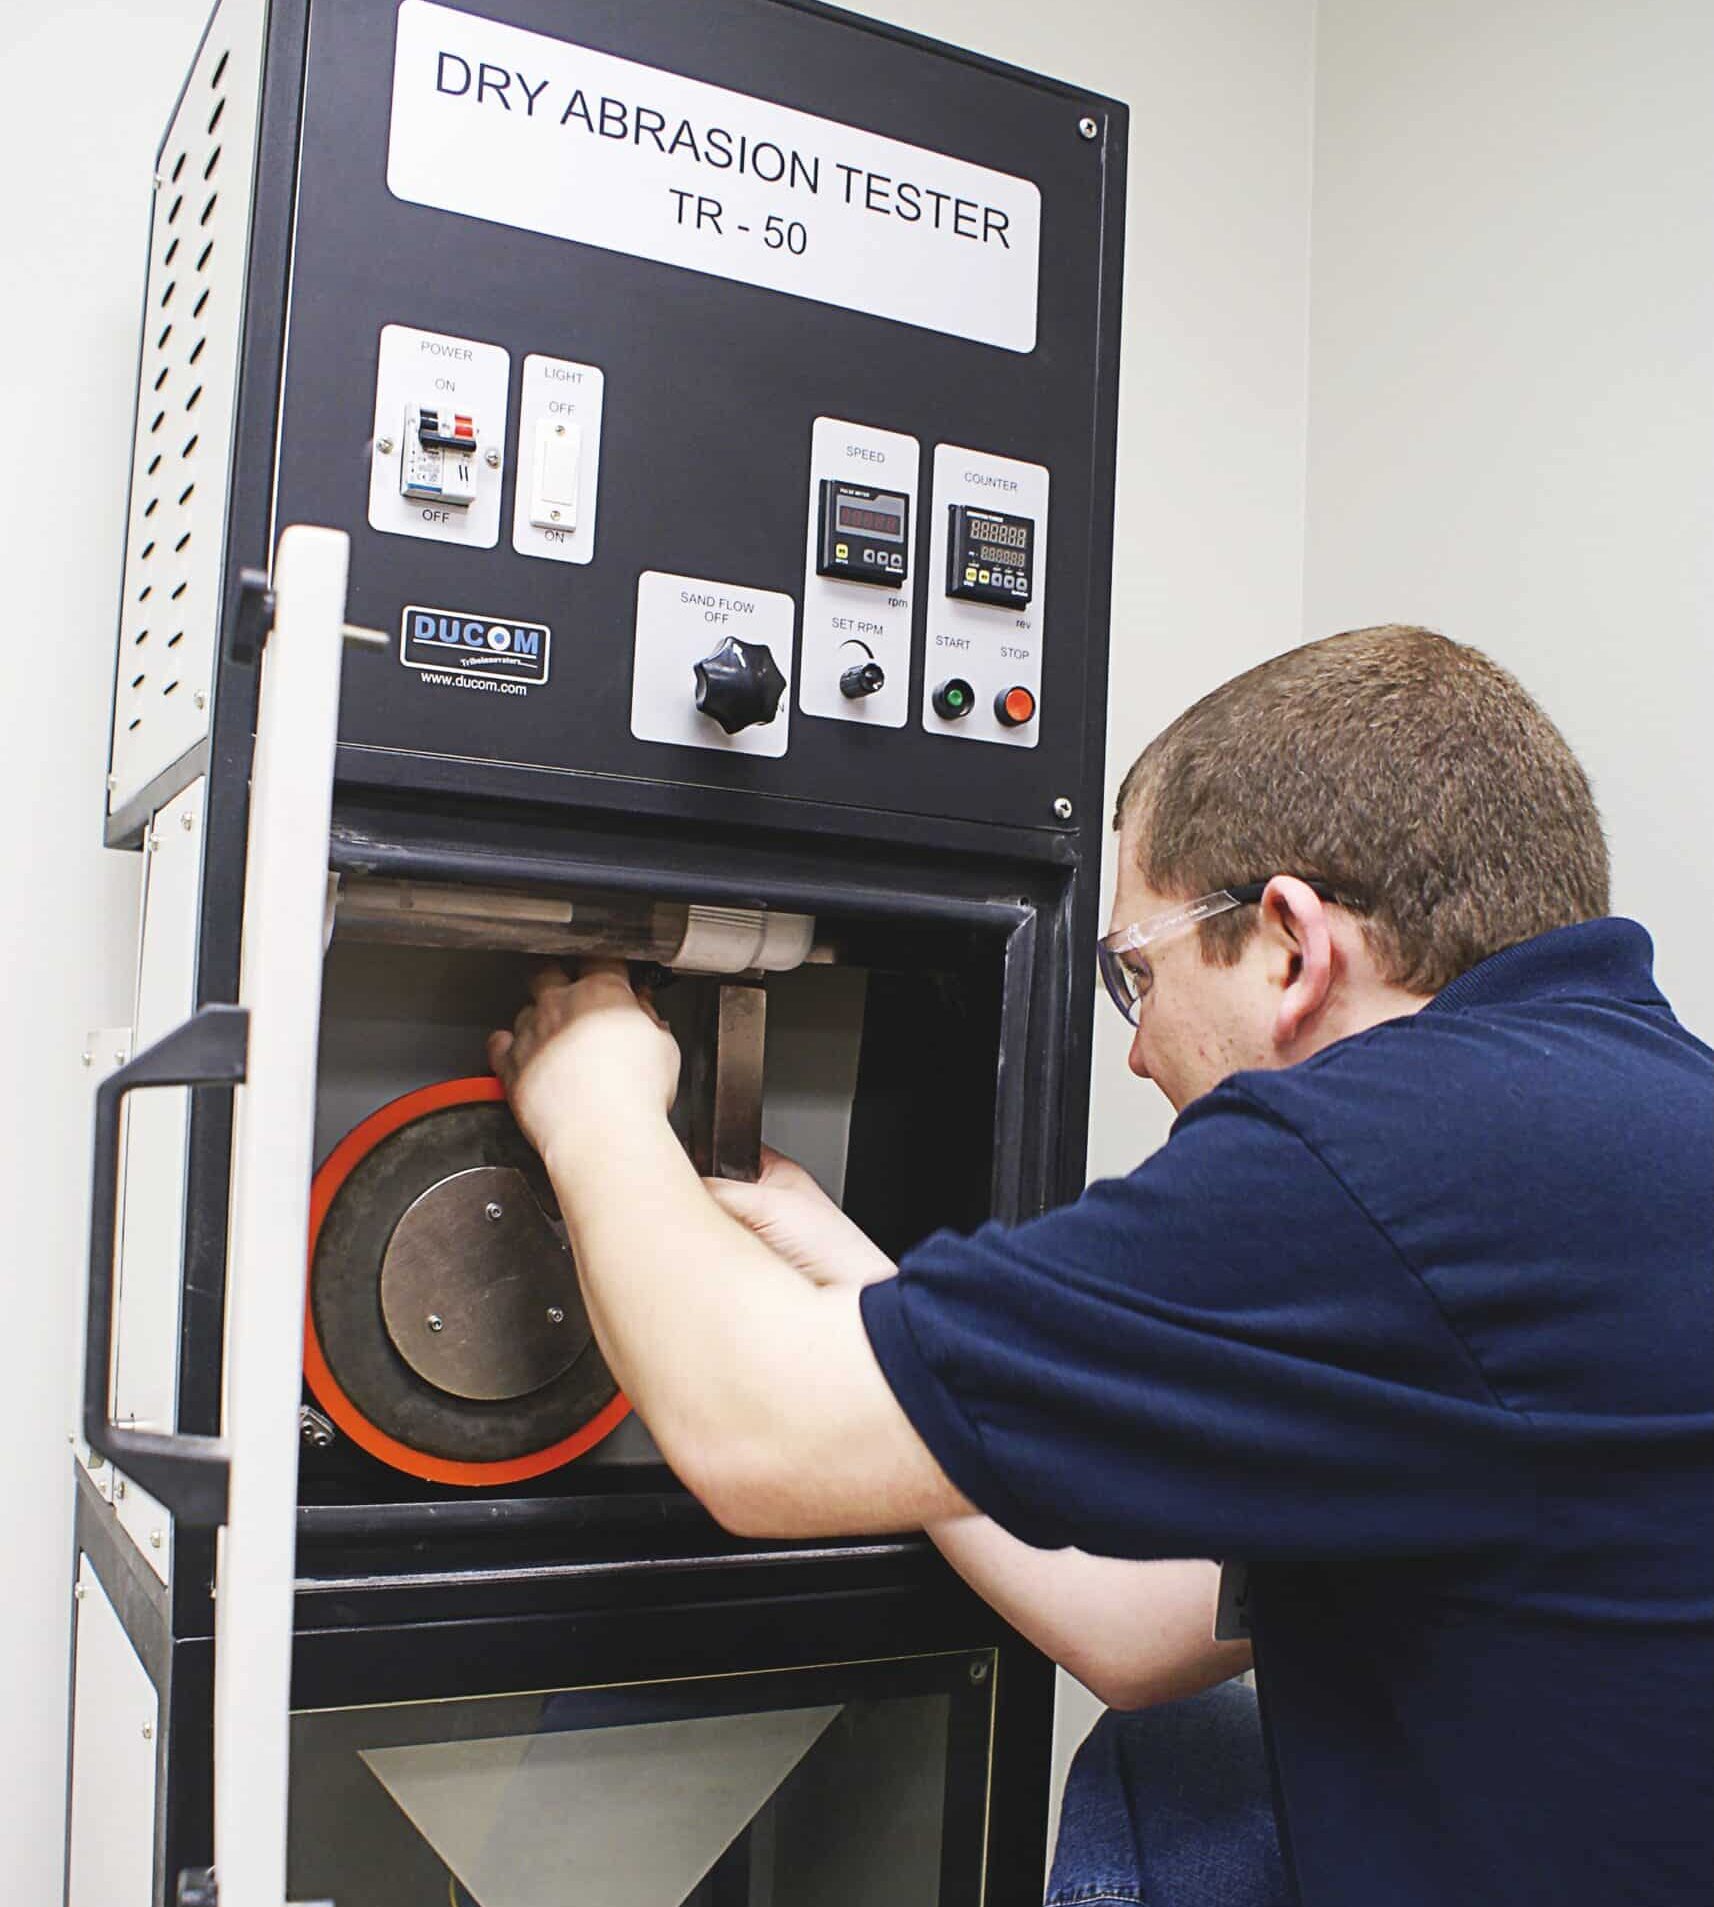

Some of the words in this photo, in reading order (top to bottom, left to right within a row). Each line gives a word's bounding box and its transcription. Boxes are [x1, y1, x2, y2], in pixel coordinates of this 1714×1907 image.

[436, 51, 549, 117] DRY
[560, 89, 820, 194] ABRASION
[835, 163, 1012, 249] TESTER
[668, 188, 724, 234] TR
[764, 216, 807, 255] 50
[420, 340, 473, 361] POWER
[434, 378, 456, 392] ON
[544, 367, 584, 385] LIGHT
[548, 401, 576, 416] OFF
[845, 445, 886, 464] SPEED
[964, 472, 1018, 493] COUNTER
[421, 508, 450, 524] OFF
[544, 530, 565, 544] ON
[680, 591, 716, 608] SAND
[718, 597, 755, 614] FLOW
[888, 597, 908, 609] rpm
[704, 611, 729, 624] OFF
[832, 617, 855, 632] SET
[857, 620, 883, 636] RPM
[1016, 619, 1032, 630] rev
[414, 615, 540, 655] DUCOM
[936, 635, 971, 651] START
[1000, 646, 1030, 661] STOP
[420, 672, 528, 697] www.ducom.com
